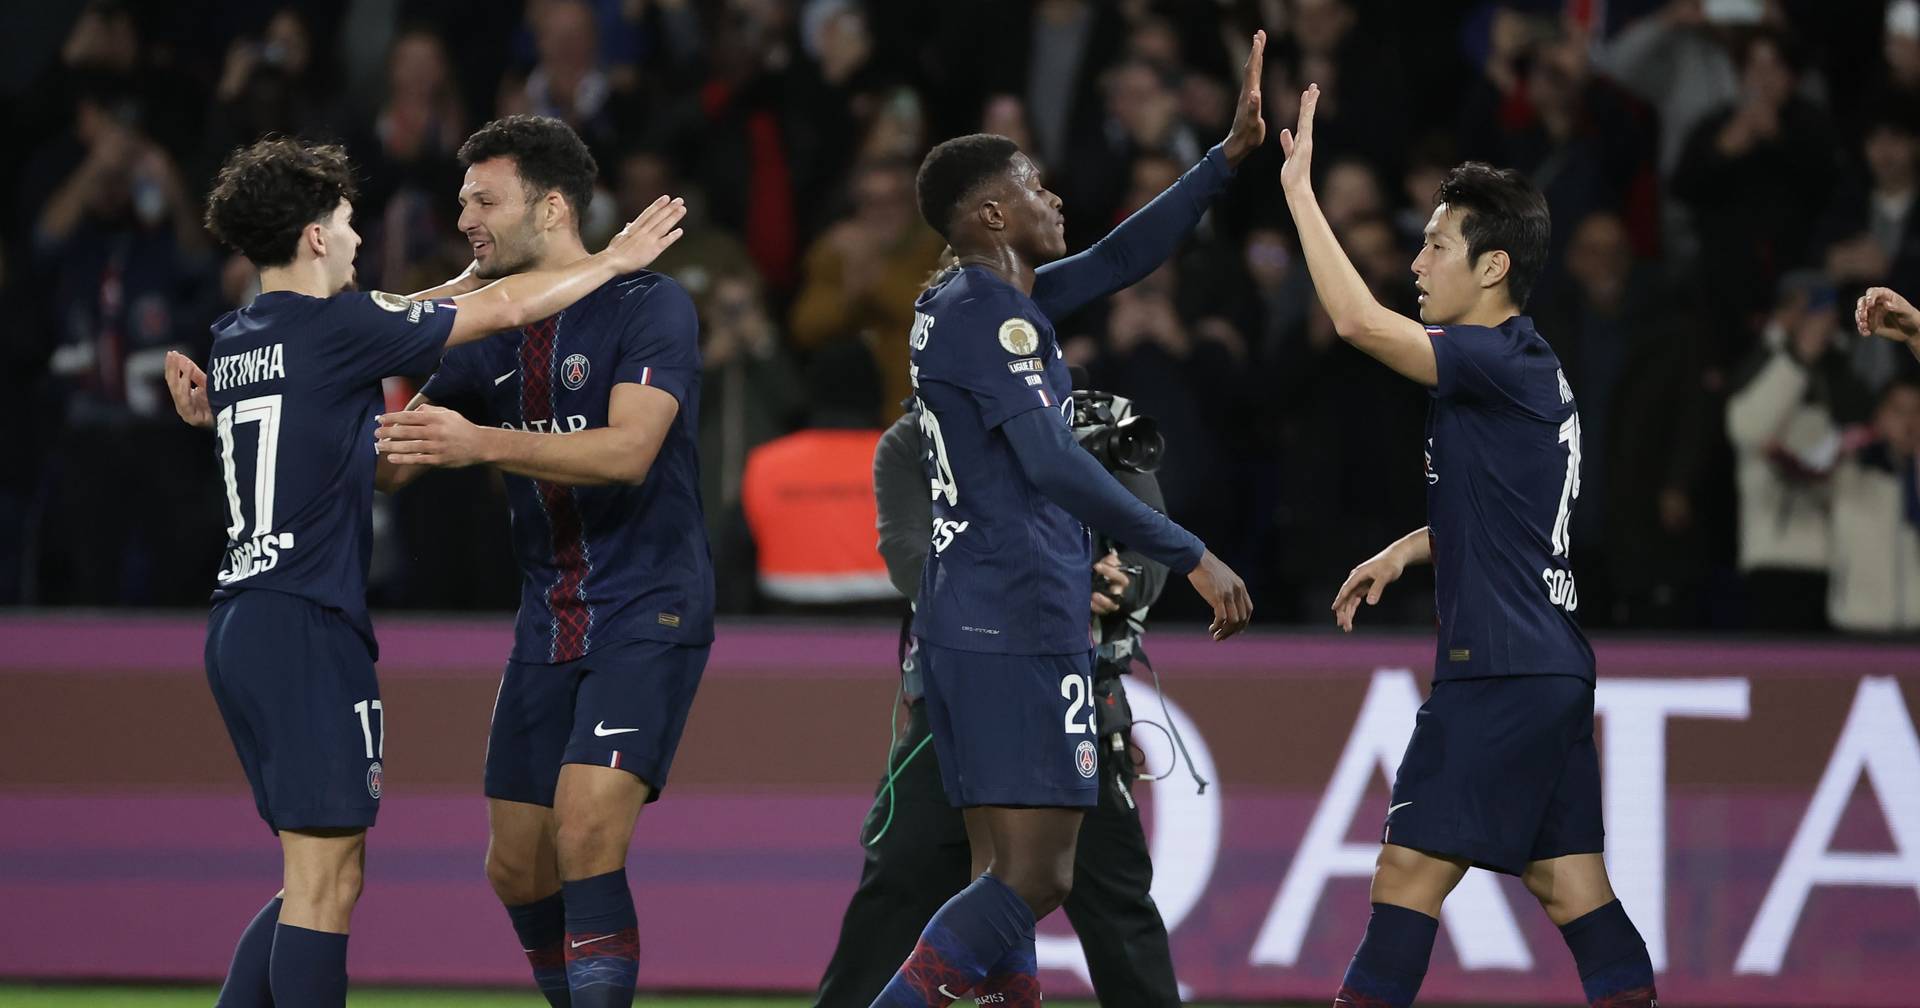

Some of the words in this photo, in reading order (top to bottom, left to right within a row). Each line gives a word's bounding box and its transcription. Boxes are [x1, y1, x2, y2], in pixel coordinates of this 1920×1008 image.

[212, 343, 286, 392] VITINHA
[217, 394, 283, 541] 17
[354, 699, 384, 759] 17
